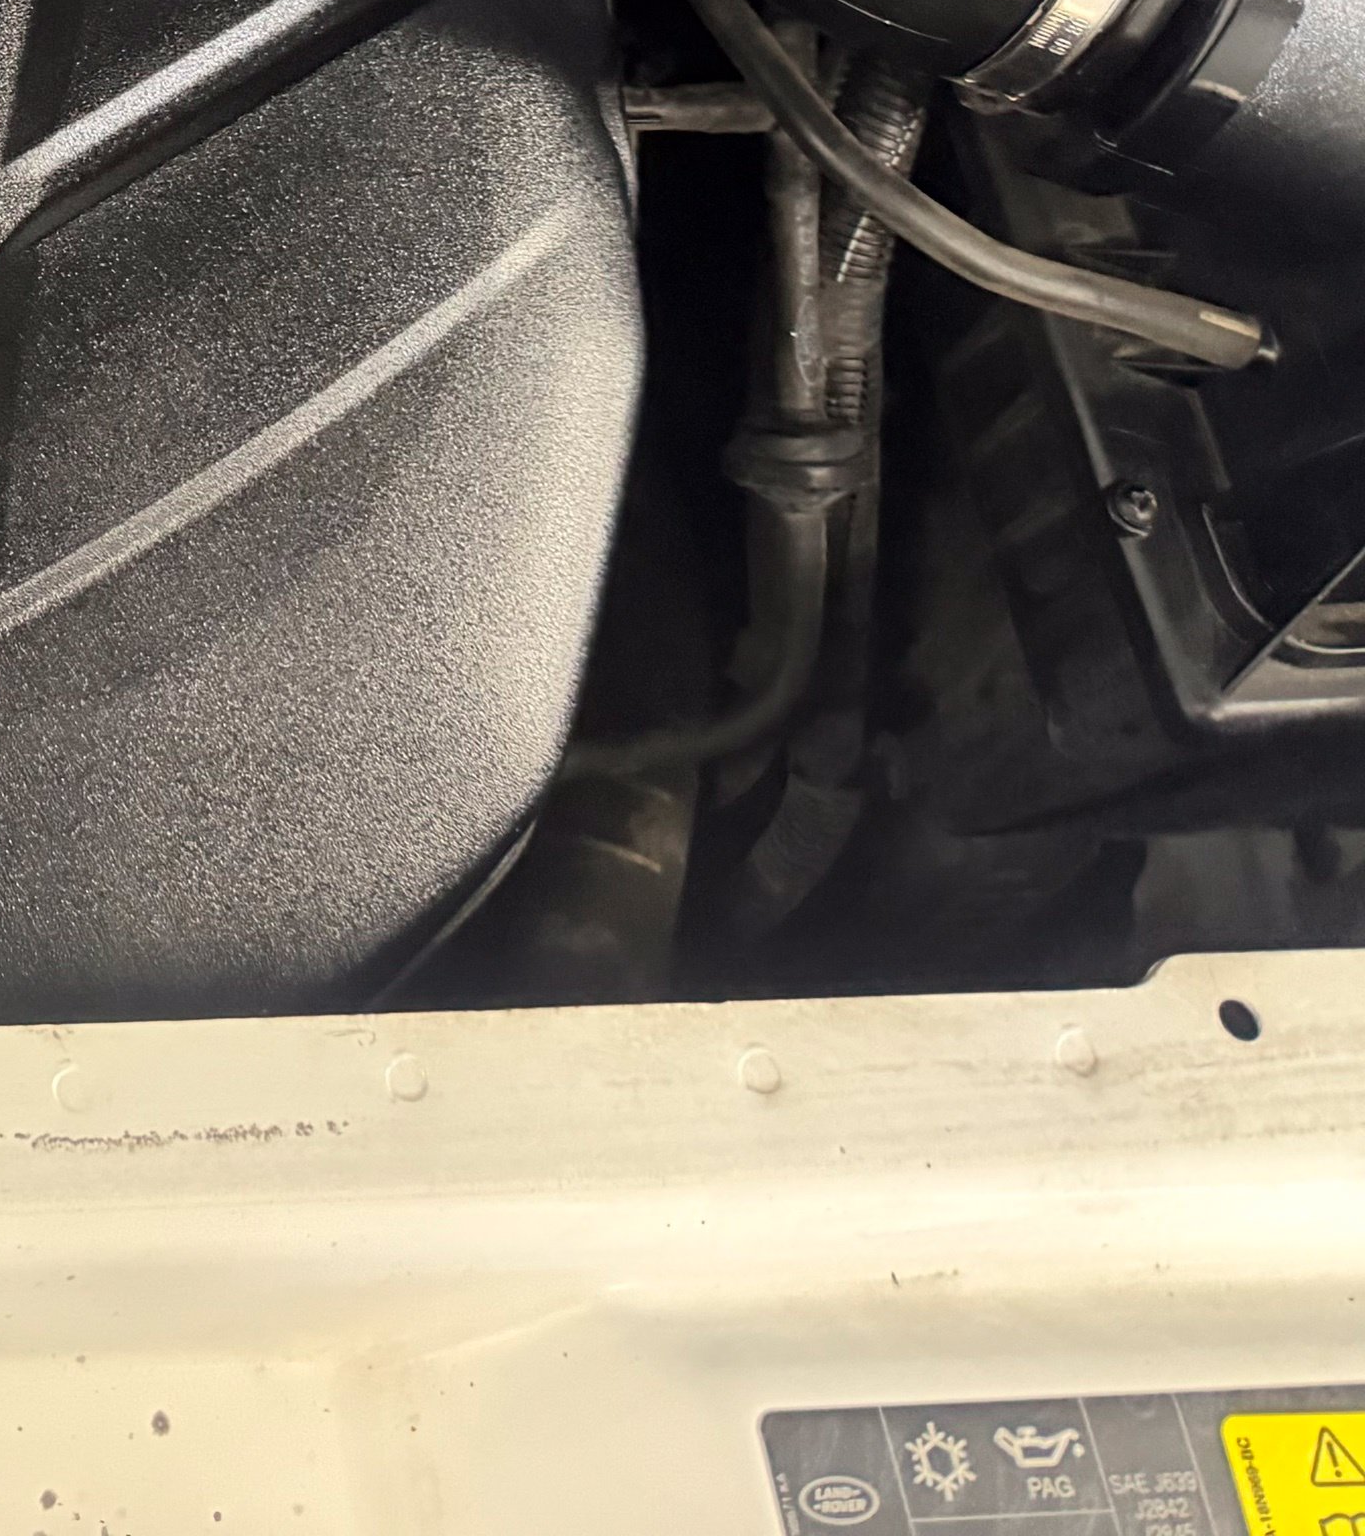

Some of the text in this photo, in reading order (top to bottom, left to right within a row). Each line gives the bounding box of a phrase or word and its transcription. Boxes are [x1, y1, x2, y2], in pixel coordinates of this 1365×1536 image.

[1026, 1474, 1077, 1500] PAG
[1108, 1470, 1198, 1495] SAE J639
[1135, 1497, 1191, 1521] J2842
